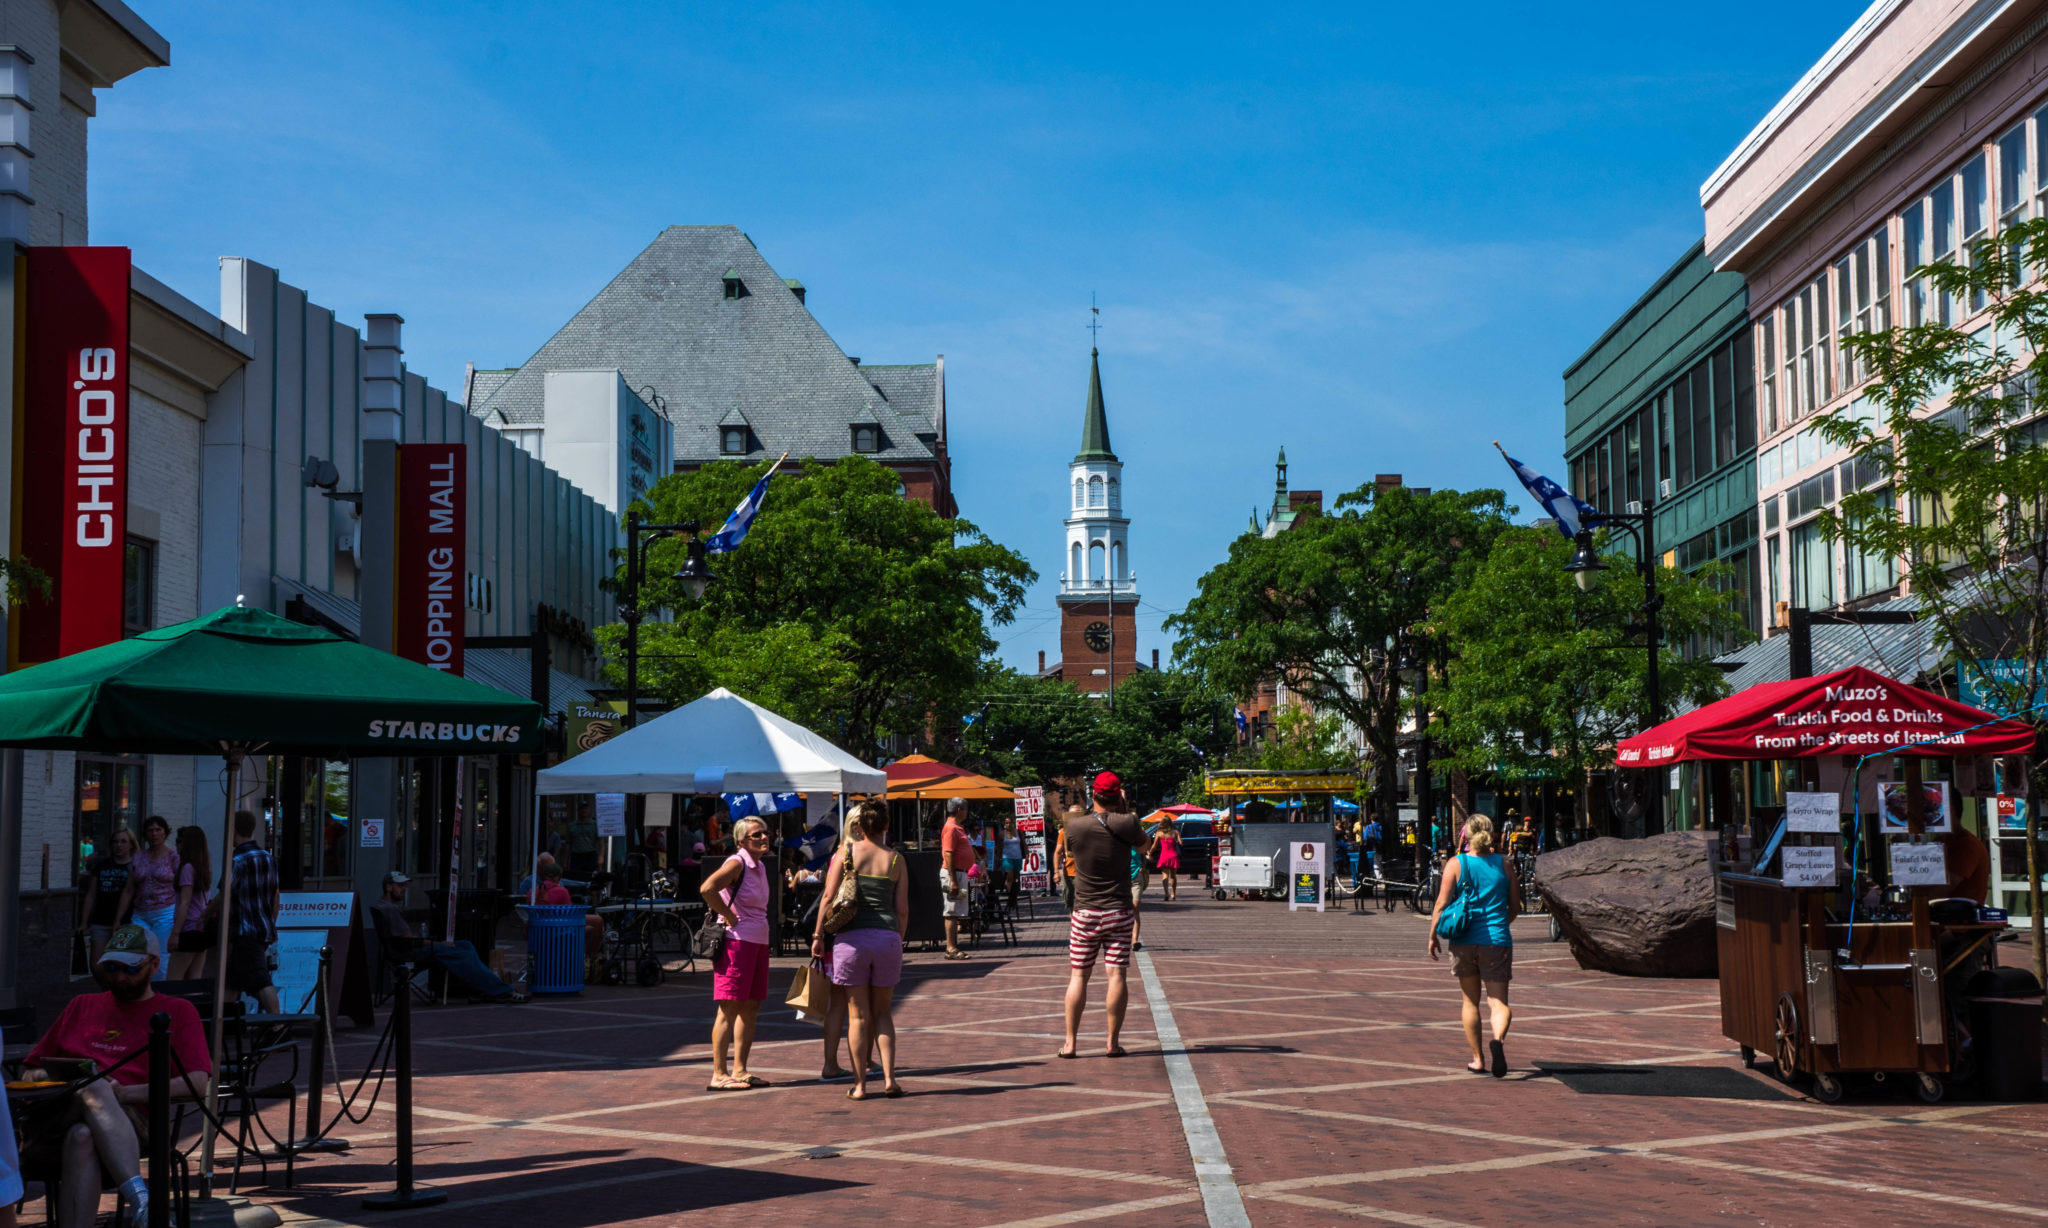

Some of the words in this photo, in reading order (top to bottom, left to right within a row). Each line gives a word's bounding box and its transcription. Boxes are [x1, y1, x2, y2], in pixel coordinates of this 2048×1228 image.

[74, 348, 116, 548] CHICO'S
[429, 453, 454, 533] MALL
[1825, 685, 1887, 702] Muzo's
[575, 706, 621, 721] Panera
[1774, 712, 1827, 726] Turkish
[1831, 708, 1872, 724] Food
[1876, 709, 1889, 723] &
[1893, 708, 1943, 724] Drinks
[368, 719, 521, 743] STARBUCKS
[1755, 735, 1796, 749] From
[1800, 733, 1824, 746] the
[1828, 731, 1880, 745] Streets
[1884, 730, 1900, 744] of
[1998, 800, 2014, 808] 0%
[1793, 808, 1811, 816] Gyro
[1814, 808, 1834, 816] Wrap
[1795, 850, 1822, 858] Stuffed
[1921, 855, 1942, 864] Wrap
[1785, 862, 1807, 871] Grape
[1799, 873, 1823, 881] $4.00
[279, 903, 347, 911] BURLINGTON
